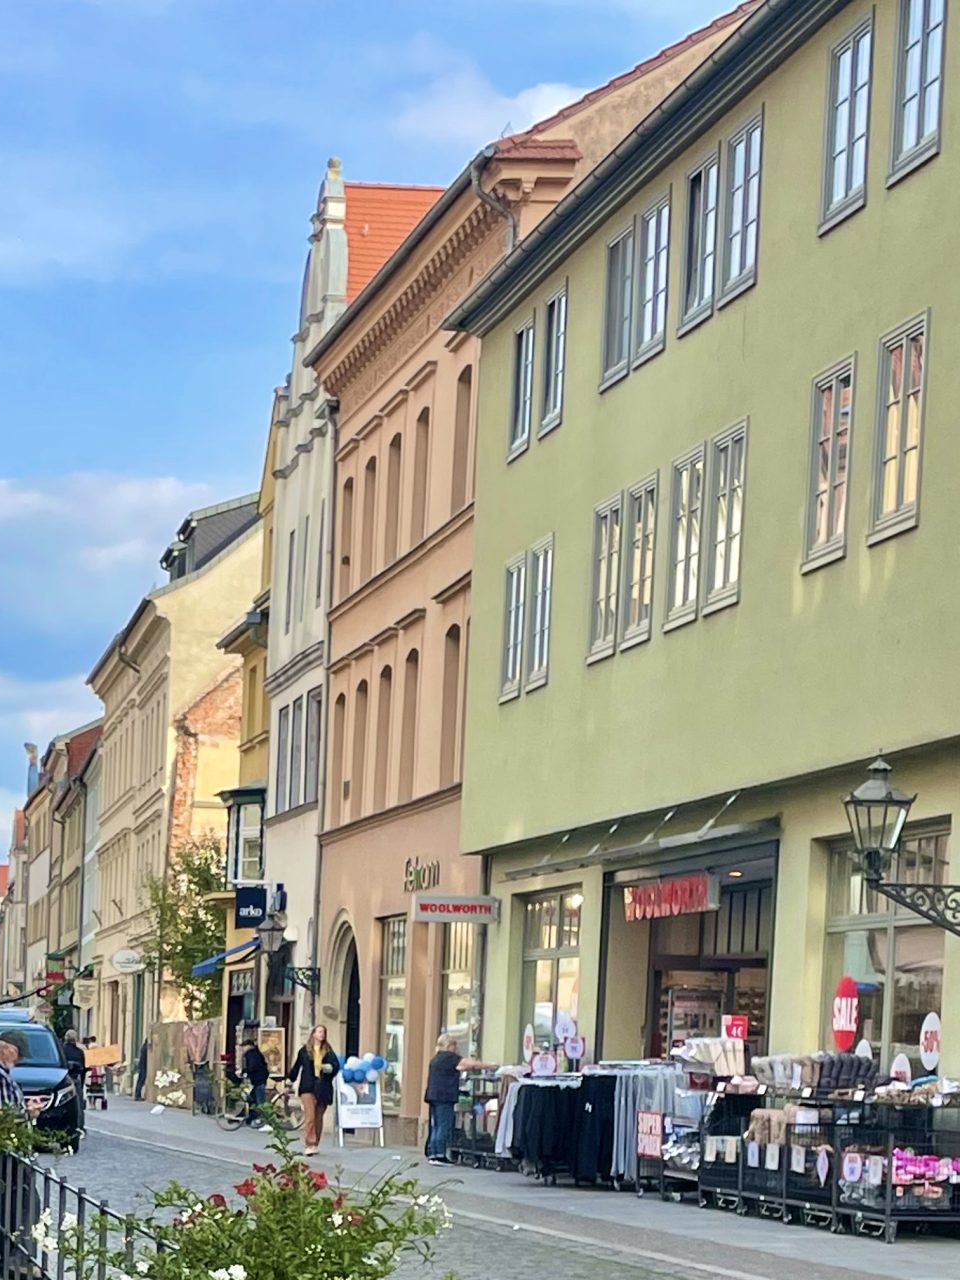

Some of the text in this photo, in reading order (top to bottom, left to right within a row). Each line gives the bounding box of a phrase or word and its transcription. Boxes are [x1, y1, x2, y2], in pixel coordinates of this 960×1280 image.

[239, 905, 263, 917] arko
[419, 902, 493, 915] WOOLWORTH
[833, 996, 859, 1032] SALE
